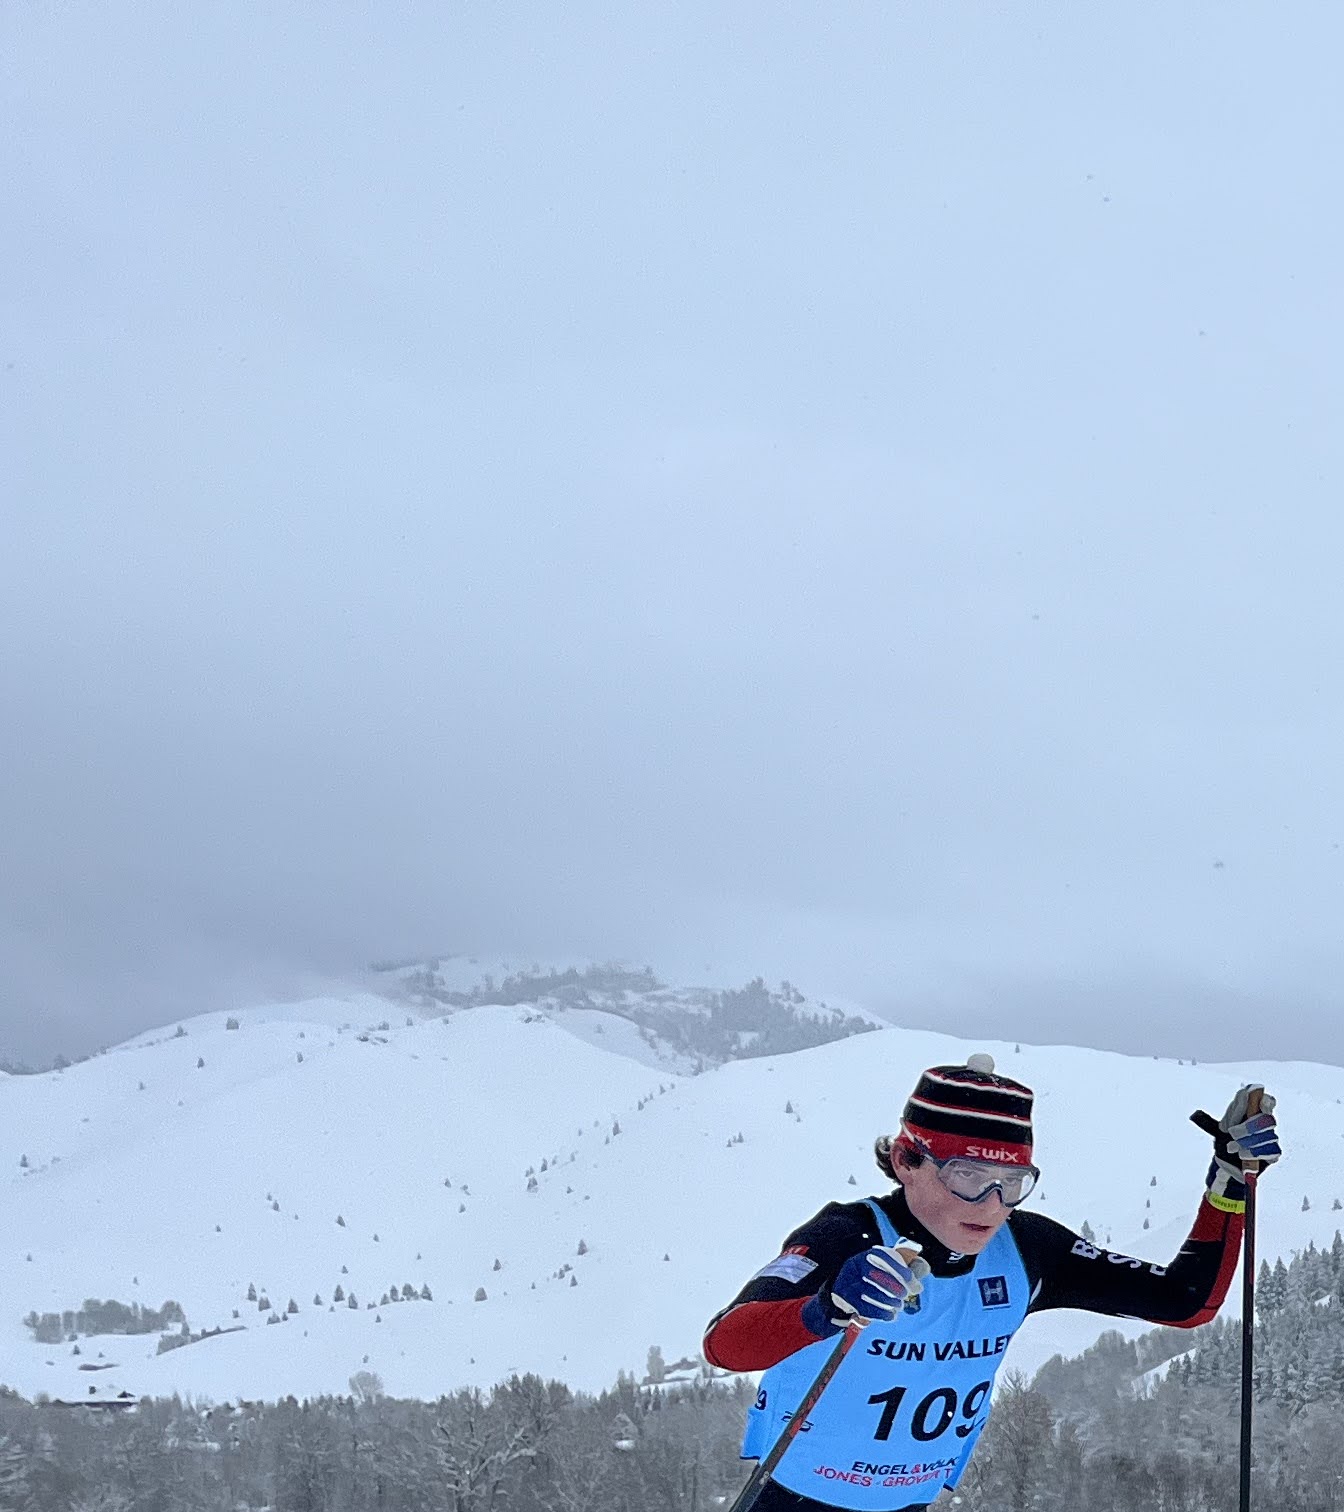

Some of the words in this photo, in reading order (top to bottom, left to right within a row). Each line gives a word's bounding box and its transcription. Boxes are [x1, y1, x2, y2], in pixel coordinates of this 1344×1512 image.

[866, 1338, 926, 1362] SUN
[867, 1380, 991, 1442] 109
[813, 1465, 872, 1487] JONES
